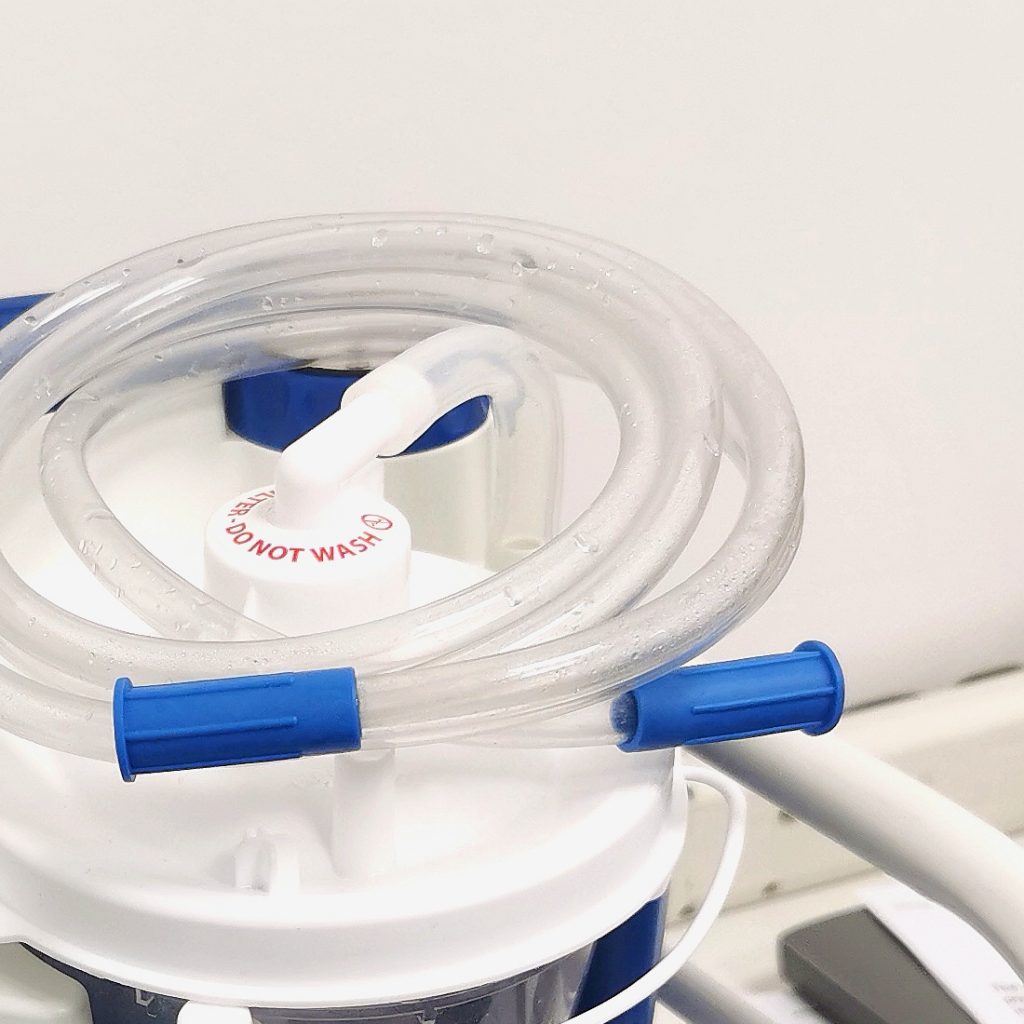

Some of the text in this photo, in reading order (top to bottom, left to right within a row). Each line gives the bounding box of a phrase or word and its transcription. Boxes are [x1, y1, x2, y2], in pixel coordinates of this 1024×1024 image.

[226, 490, 382, 563] LTER DO NOT WASH
